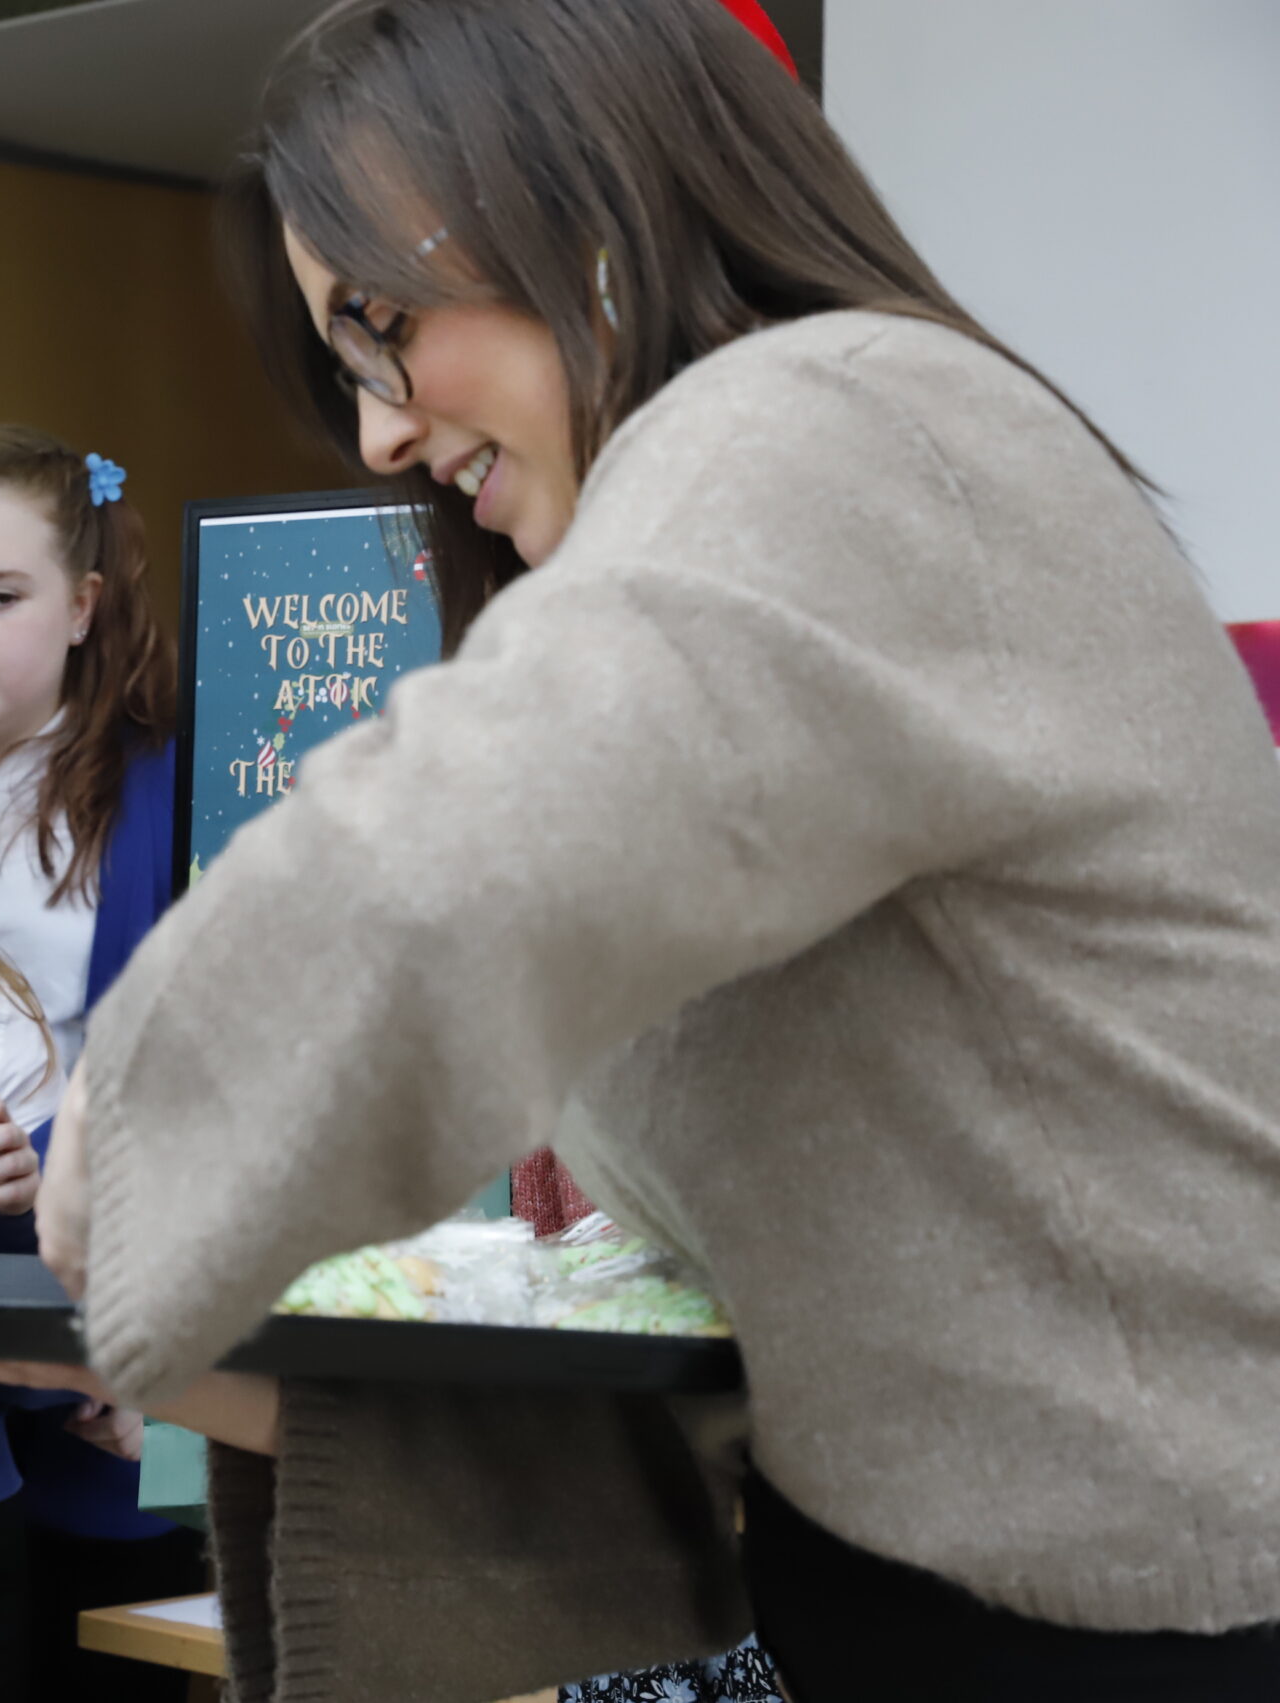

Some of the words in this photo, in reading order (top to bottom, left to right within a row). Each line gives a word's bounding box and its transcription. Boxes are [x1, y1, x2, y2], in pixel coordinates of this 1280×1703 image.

[242, 589, 408, 629] WELCOME
[261, 634, 310, 671] TO
[318, 632, 385, 669] THE
[273, 673, 377, 712] ATTIC
[229, 759, 293, 797] THE
